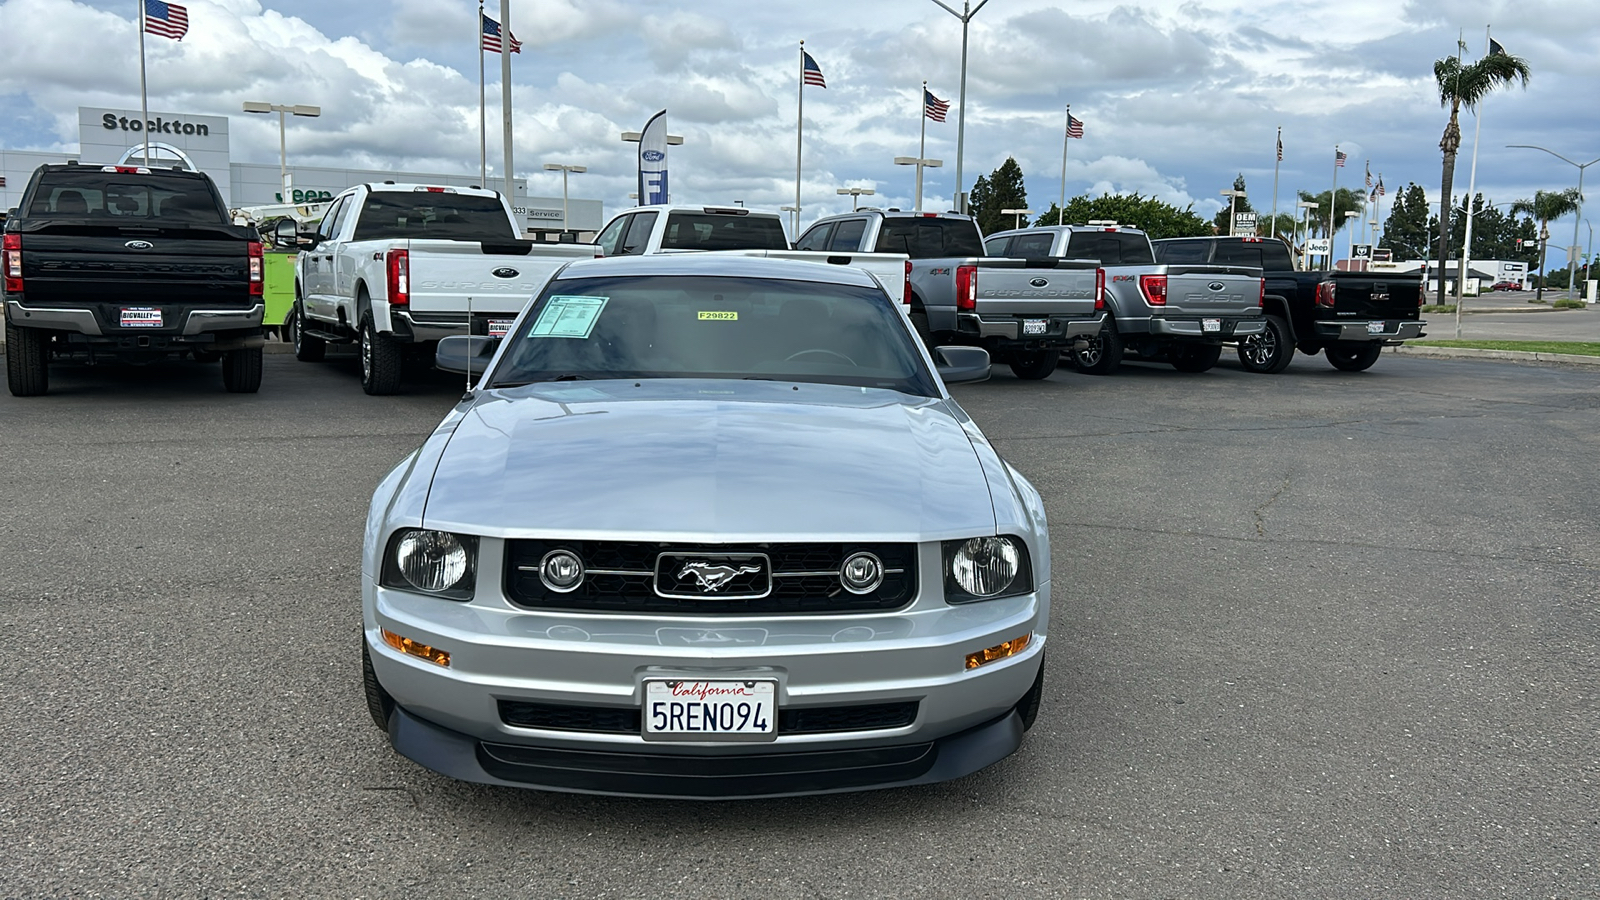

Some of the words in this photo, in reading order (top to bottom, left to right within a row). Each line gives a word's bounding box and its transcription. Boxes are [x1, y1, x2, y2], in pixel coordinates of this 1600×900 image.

[102, 113, 209, 136] Stockton
[642, 172, 662, 205] F
[1236, 213, 1256, 221] OEM
[1309, 243, 1328, 252] Jeep
[1112, 275, 1135, 283] FX4
[421, 280, 513, 290] SUPER
[984, 289, 1044, 297] SUPER
[672, 681, 754, 701] California
[652, 701, 768, 731] 5REN094
